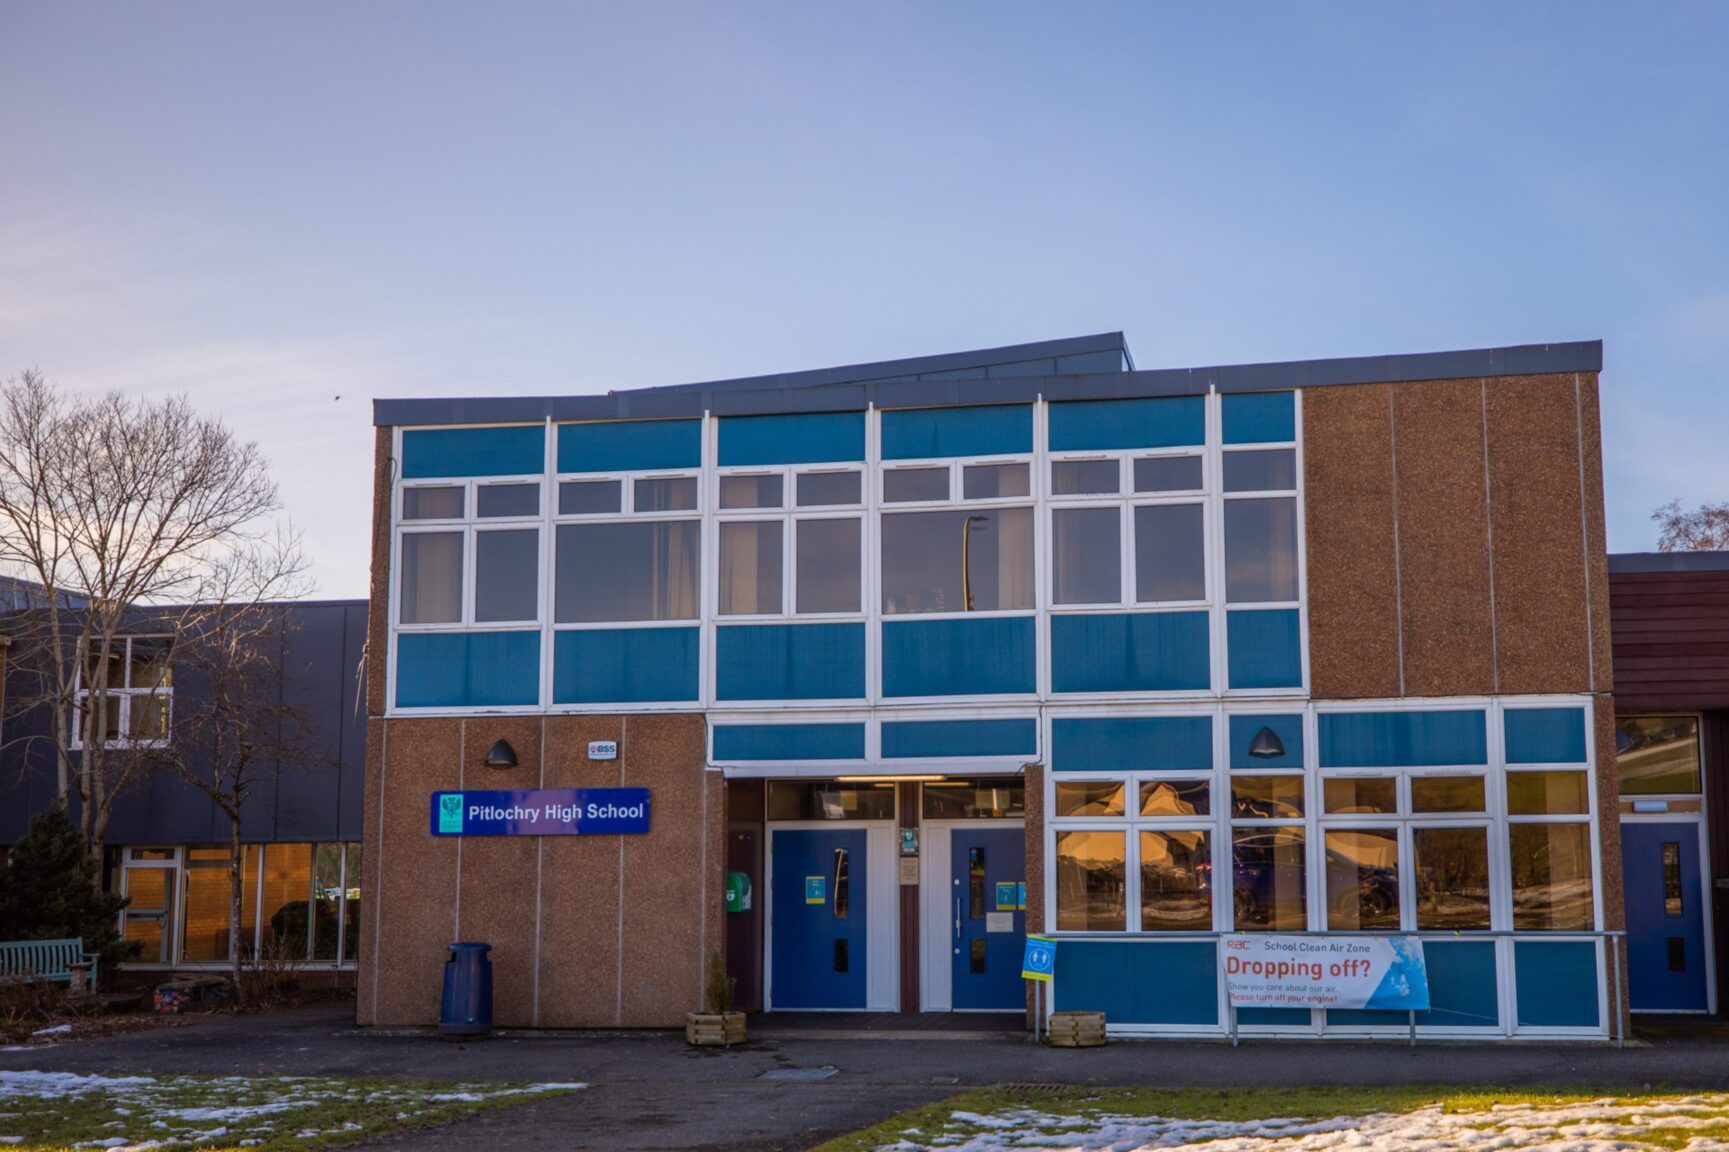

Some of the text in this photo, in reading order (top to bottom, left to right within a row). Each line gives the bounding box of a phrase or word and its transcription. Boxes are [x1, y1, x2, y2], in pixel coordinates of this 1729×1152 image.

[469, 803, 643, 823] Pitlochry High School
[1264, 941, 1371, 953] School Clean Air Zone
[1227, 956, 1372, 980] Dropping off?
[1250, 984, 1264, 992] you
[1285, 984, 1308, 992] about
[1256, 993, 1273, 1001] turn
[1275, 993, 1286, 1001] off
[1287, 995, 1305, 1003] your
[1307, 995, 1338, 1004] engine!
